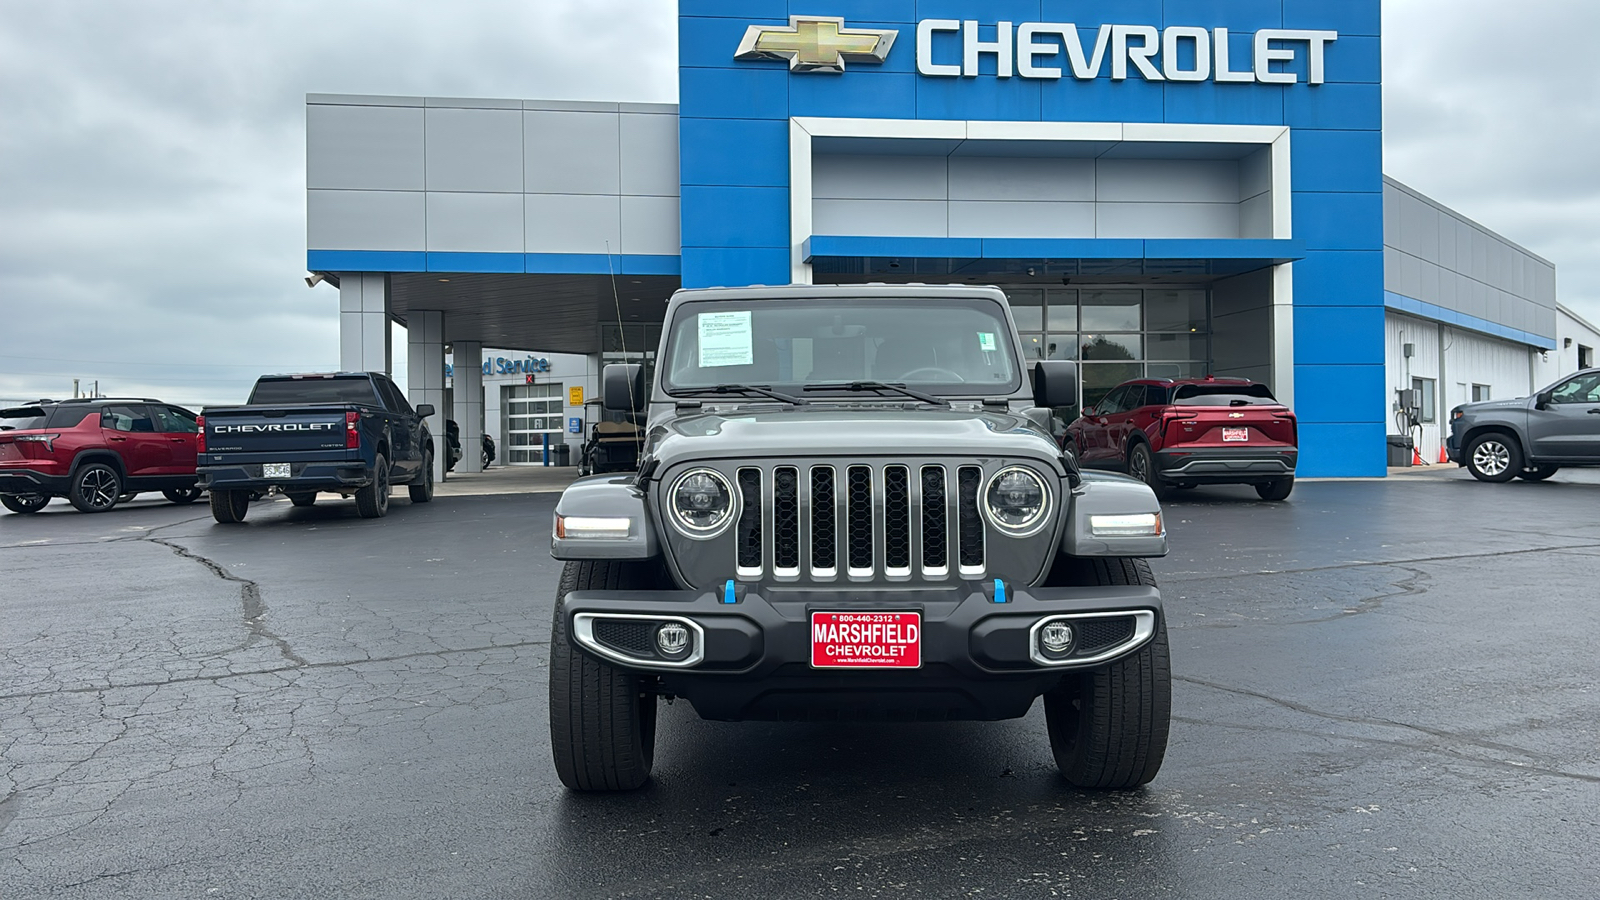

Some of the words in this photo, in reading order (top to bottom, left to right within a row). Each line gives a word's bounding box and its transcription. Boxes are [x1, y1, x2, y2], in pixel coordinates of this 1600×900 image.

[916, 18, 1338, 85] CHEVROLET
[496, 355, 549, 375] Service
[214, 423, 336, 433] CHEVROLET
[814, 623, 919, 644] MARSHFIELD
[825, 645, 907, 656] CHEVROLET
